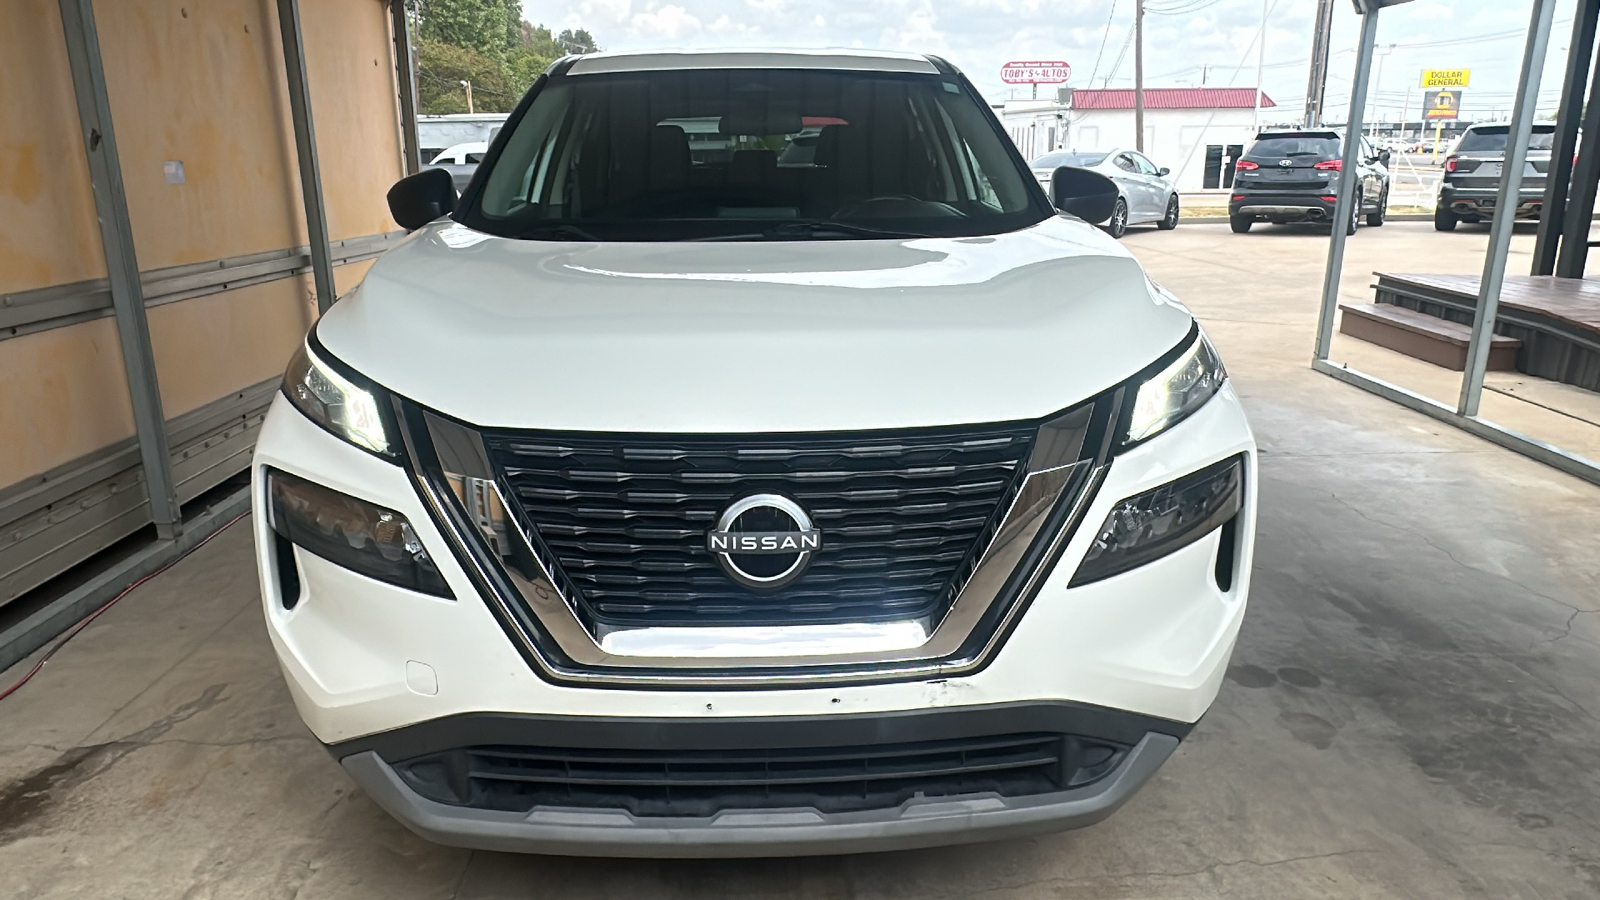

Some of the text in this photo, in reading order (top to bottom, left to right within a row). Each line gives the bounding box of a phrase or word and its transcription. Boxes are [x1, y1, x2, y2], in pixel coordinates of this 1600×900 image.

[1003, 68, 1068, 78] TOBY'S AUTOS
[711, 534, 818, 550] NISSAN
